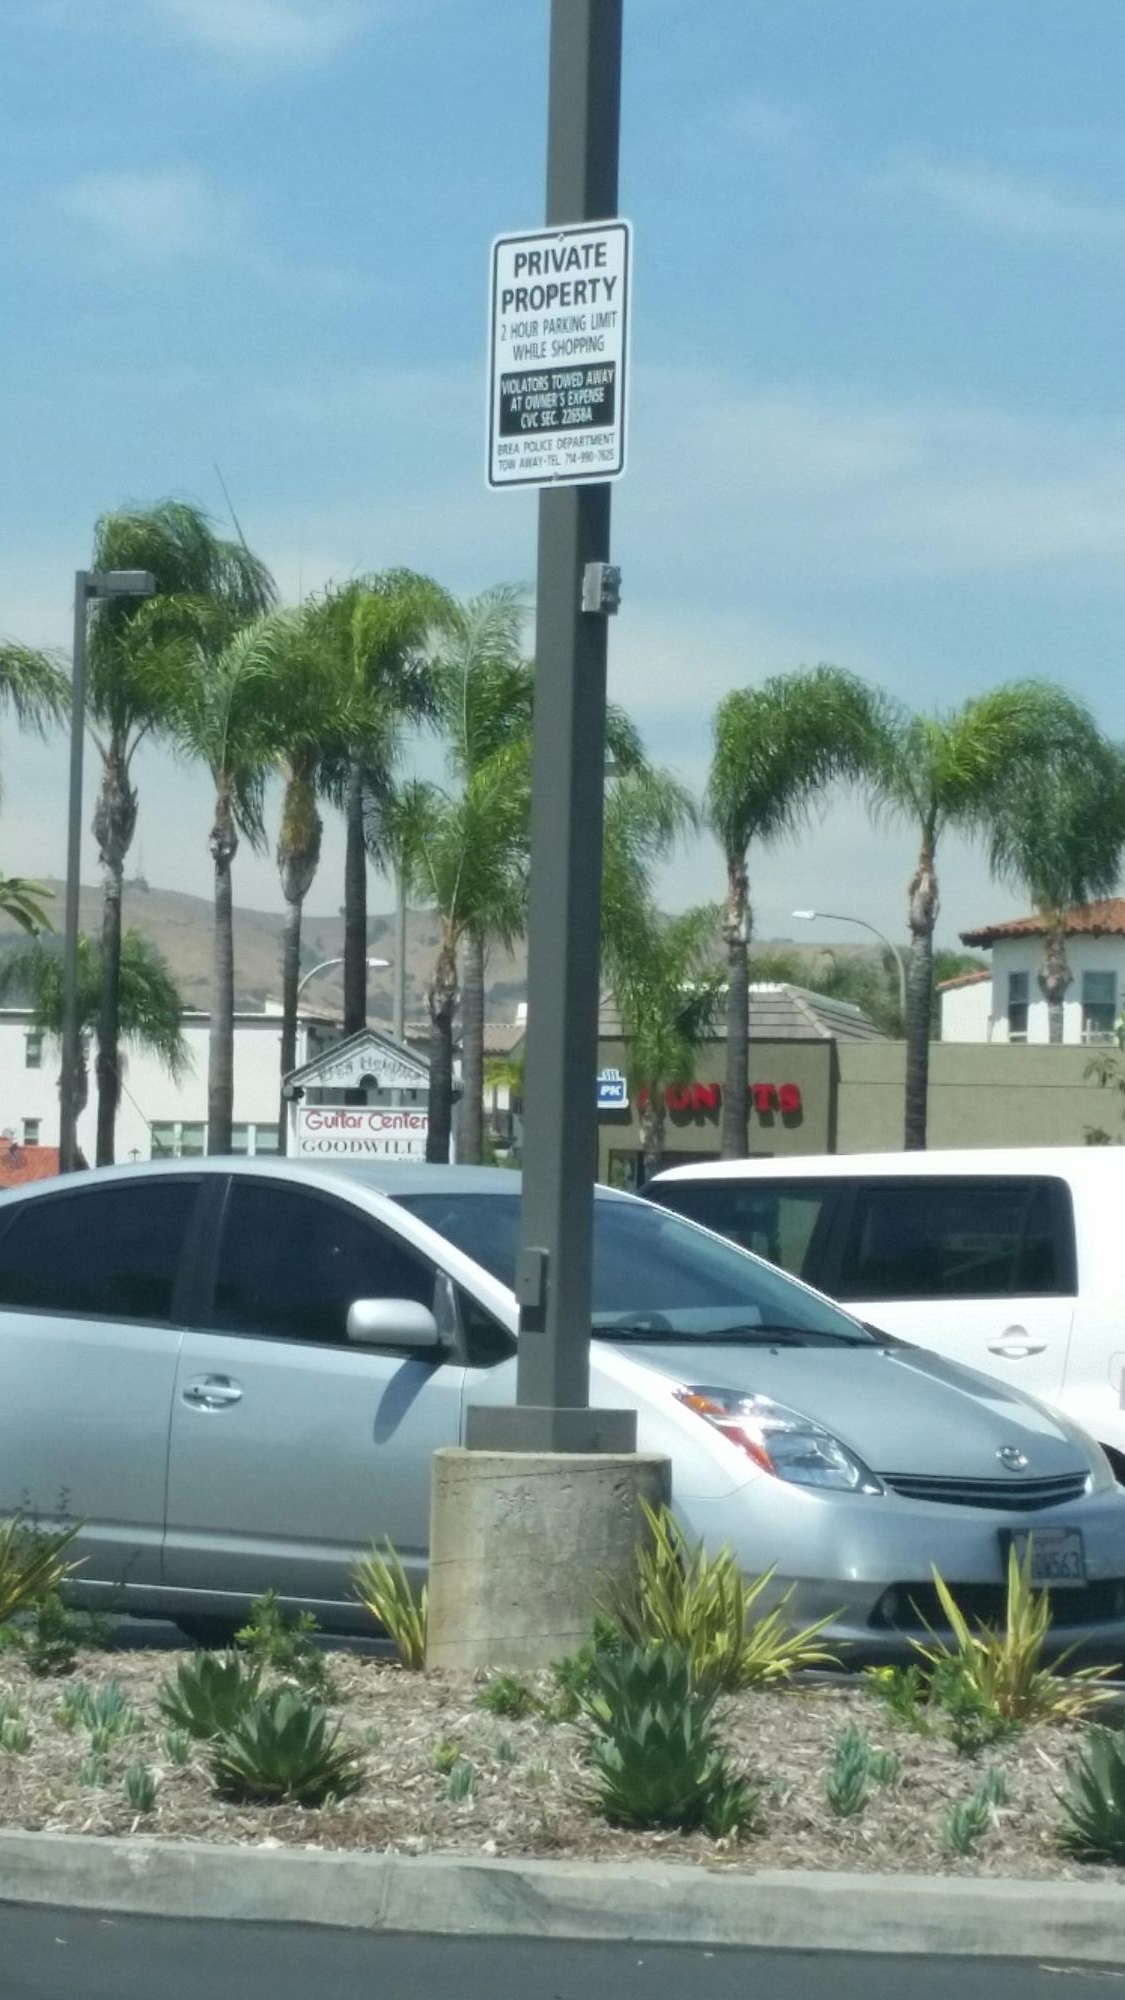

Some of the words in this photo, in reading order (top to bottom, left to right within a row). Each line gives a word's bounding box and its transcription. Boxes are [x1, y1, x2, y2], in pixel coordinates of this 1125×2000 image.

[514, 242, 607, 278] PRIVATE
[501, 275, 618, 314] PROPERTY
[500, 324, 507, 341] 2
[511, 321, 539, 340] HOUR
[543, 315, 587, 335] PARKING
[591, 311, 618, 331] LIMIT
[513, 341, 547, 361] WHILE
[551, 335, 605, 357] SHOPPING
[501, 375, 549, 395] VIOLATORS
[551, 372, 584, 390] TOWED
[586, 369, 614, 385] AWAY
[510, 397, 522, 412] AT
[525, 391, 566, 410] OWNER'S
[568, 387, 605, 405] EXPENSE
[520, 412, 539, 429] CVC
[541, 410, 559, 427] SEC.
[498, 444, 520, 456] BREA
[523, 439, 553, 453] POLICE
[557, 433, 615, 449] DEPARTMENT
[498, 459, 516, 471] TOW
[600, 1085, 622, 1096] PK
[637, 1082, 801, 1113] UNTS
[305, 1109, 364, 1131] Guitar
[368, 1110, 429, 1132] Center
[302, 1139, 417, 1155] GOODWILL
